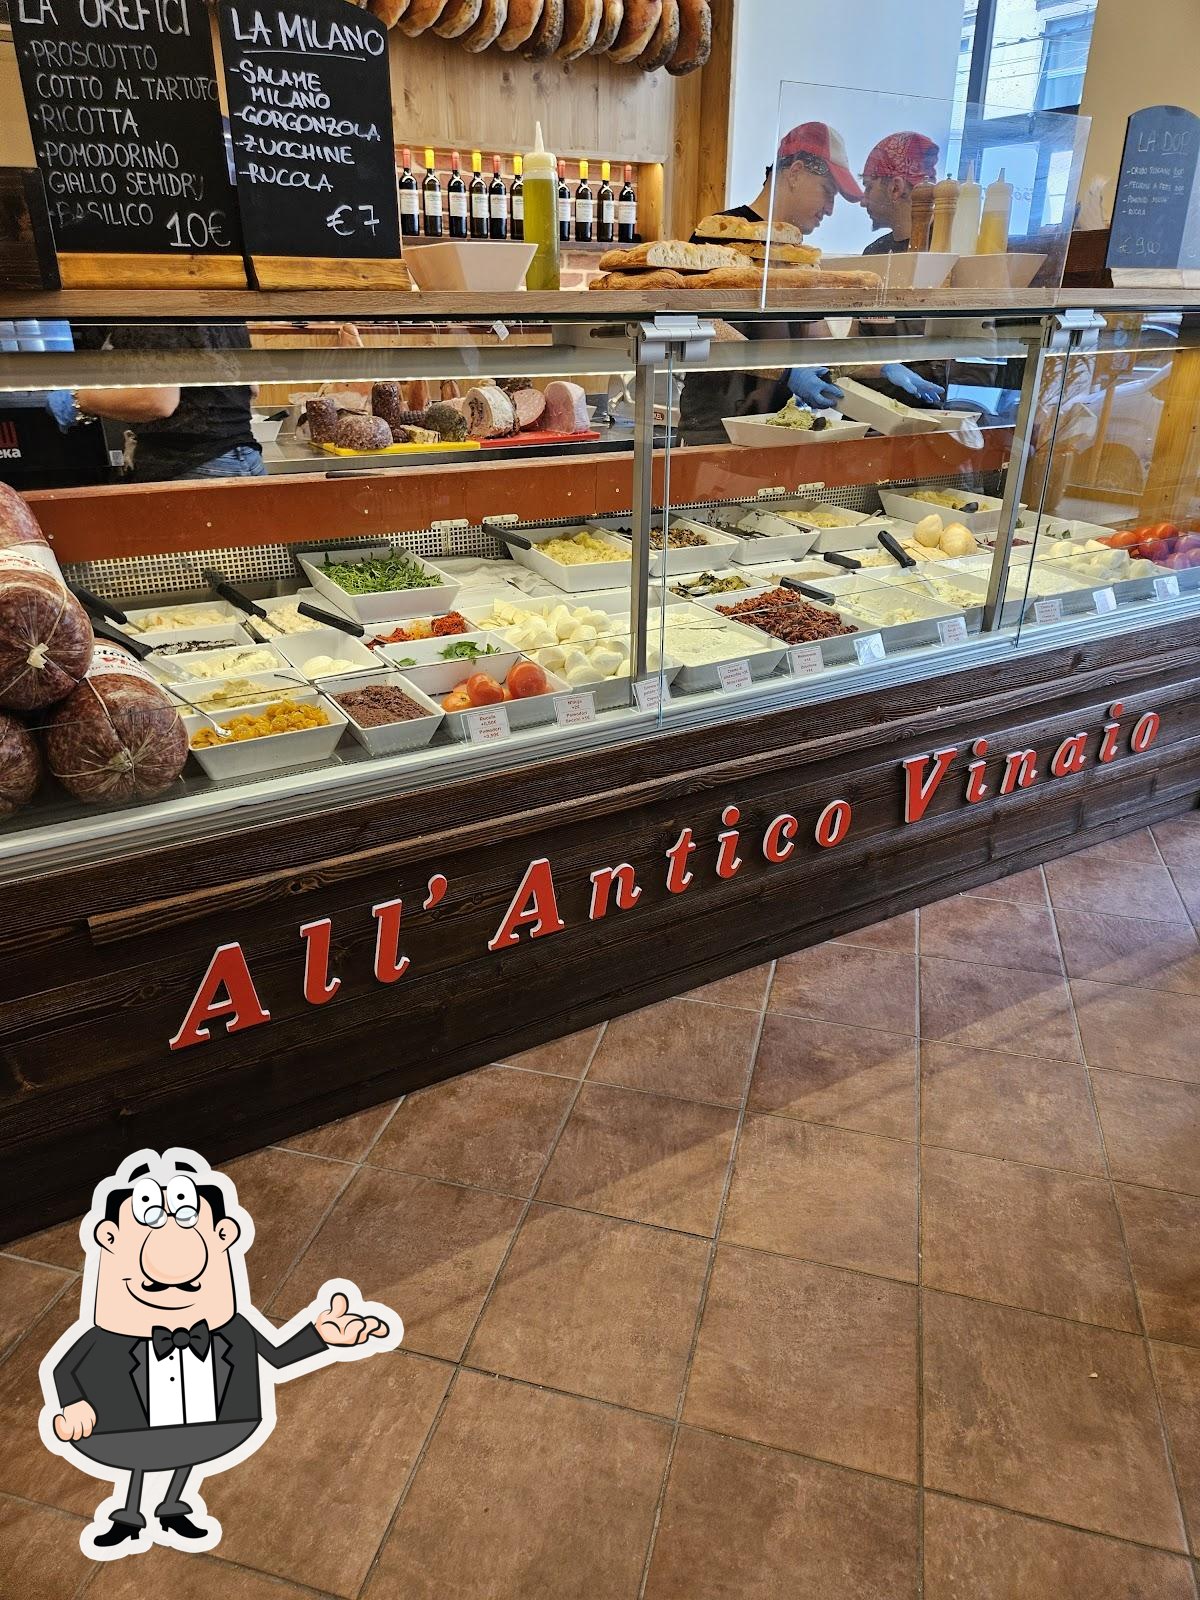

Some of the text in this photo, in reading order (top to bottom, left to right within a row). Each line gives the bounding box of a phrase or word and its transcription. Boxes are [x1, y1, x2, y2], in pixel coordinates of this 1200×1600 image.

[231, 8, 384, 56] LA MILANO
[29, 39, 158, 71] PROSCIUTTO
[36, 73, 219, 101] COTTO AL TARTUFO
[251, 86, 331, 109] MILANO
[39, 103, 140, 138] RICOTTA
[42, 140, 179, 170] POMODORINO
[49, 171, 117, 196] GIALLO
[166, 210, 231, 248] 10€
[169, 701, 1160, 1051] All' Antico Vinaio
